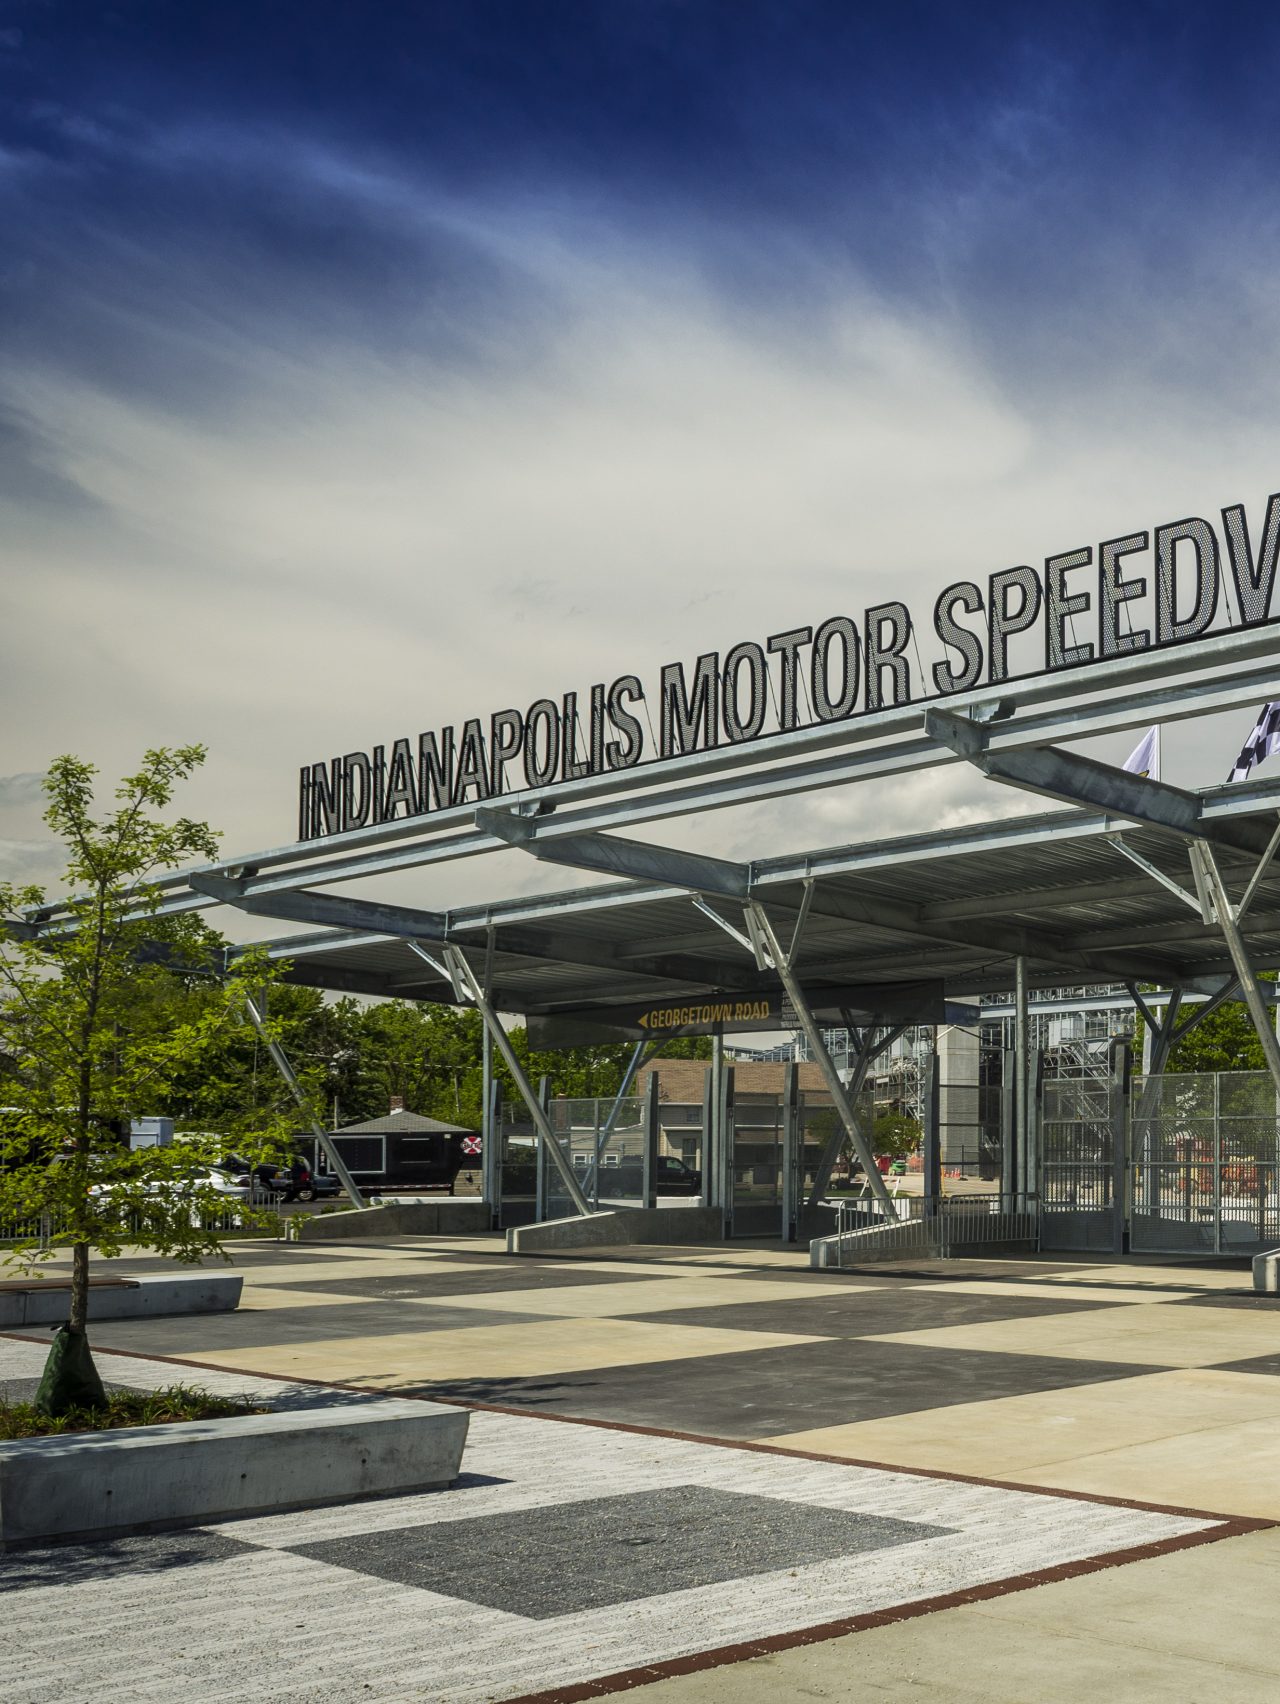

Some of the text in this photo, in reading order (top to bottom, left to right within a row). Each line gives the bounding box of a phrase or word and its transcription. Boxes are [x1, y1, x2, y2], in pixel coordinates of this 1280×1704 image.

[298, 675, 645, 841] INDIANAPOLIS
[660, 601, 911, 757] MOTOR
[650, 1004, 731, 1028] GEORGETOWN
[734, 1002, 770, 1019] ROAD
